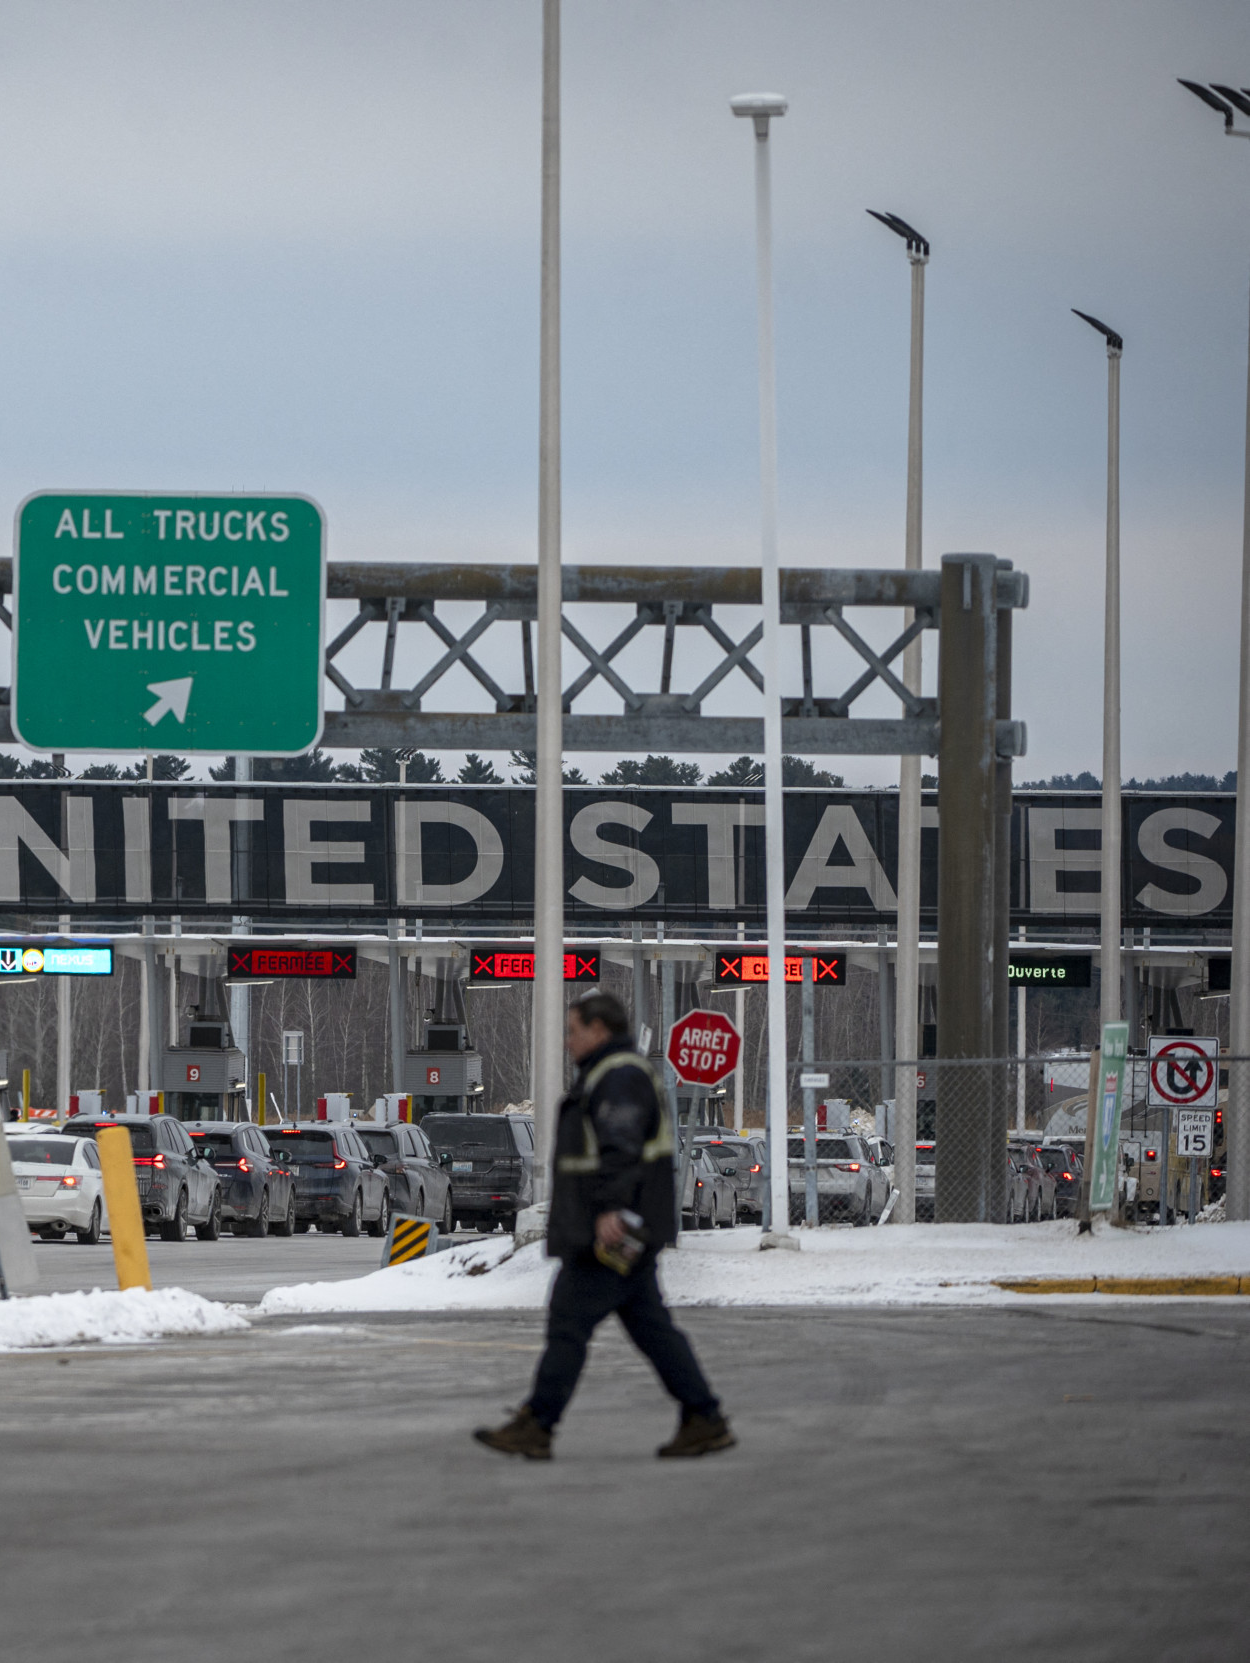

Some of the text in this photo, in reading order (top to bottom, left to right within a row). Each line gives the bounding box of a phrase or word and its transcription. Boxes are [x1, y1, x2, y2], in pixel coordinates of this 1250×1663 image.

[54, 509, 291, 542] ALL TRUCKS
[52, 564, 290, 598] COMMERCIAL
[83, 619, 257, 652] VEHICLES
[567, 800, 1229, 917] STAES
[257, 952, 325, 971] FERMÉE
[500, 959, 567, 974] FER
[753, 963, 803, 976] CLSE
[1007, 964, 1066, 979] Ouverte
[679, 1026, 732, 1052] ARRÊT
[677, 1047, 727, 1072] STOP
[190, 1068, 199, 1081] 9
[430, 1071, 439, 1083] 8
[917, 1075, 925, 1087] 6
[1181, 1113, 1211, 1123] SPEED
[1183, 1124, 1207, 1132] LIMIT
[1183, 1134, 1206, 1152] 15
